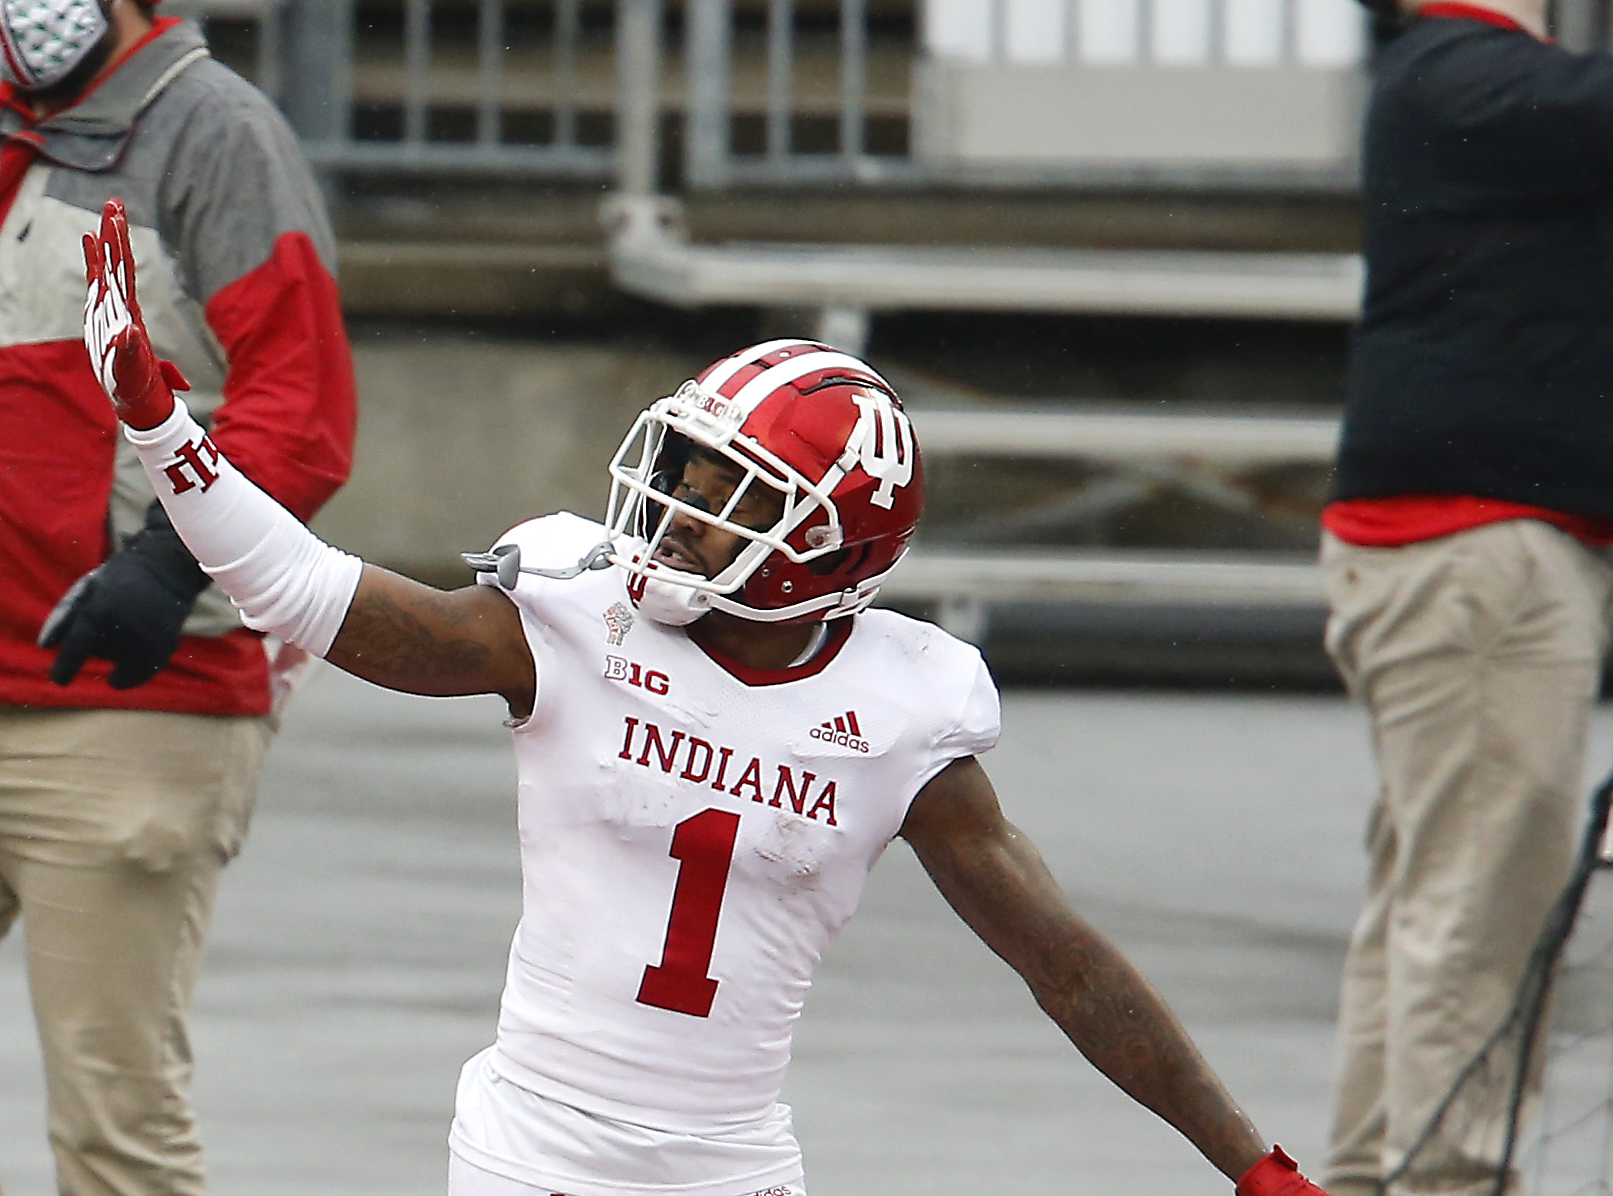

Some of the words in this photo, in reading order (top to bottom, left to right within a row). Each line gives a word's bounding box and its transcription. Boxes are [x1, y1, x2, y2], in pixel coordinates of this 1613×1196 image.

[618, 715, 839, 827] INDIANA
[809, 726, 871, 754] adidas
[635, 806, 743, 1019] 1
